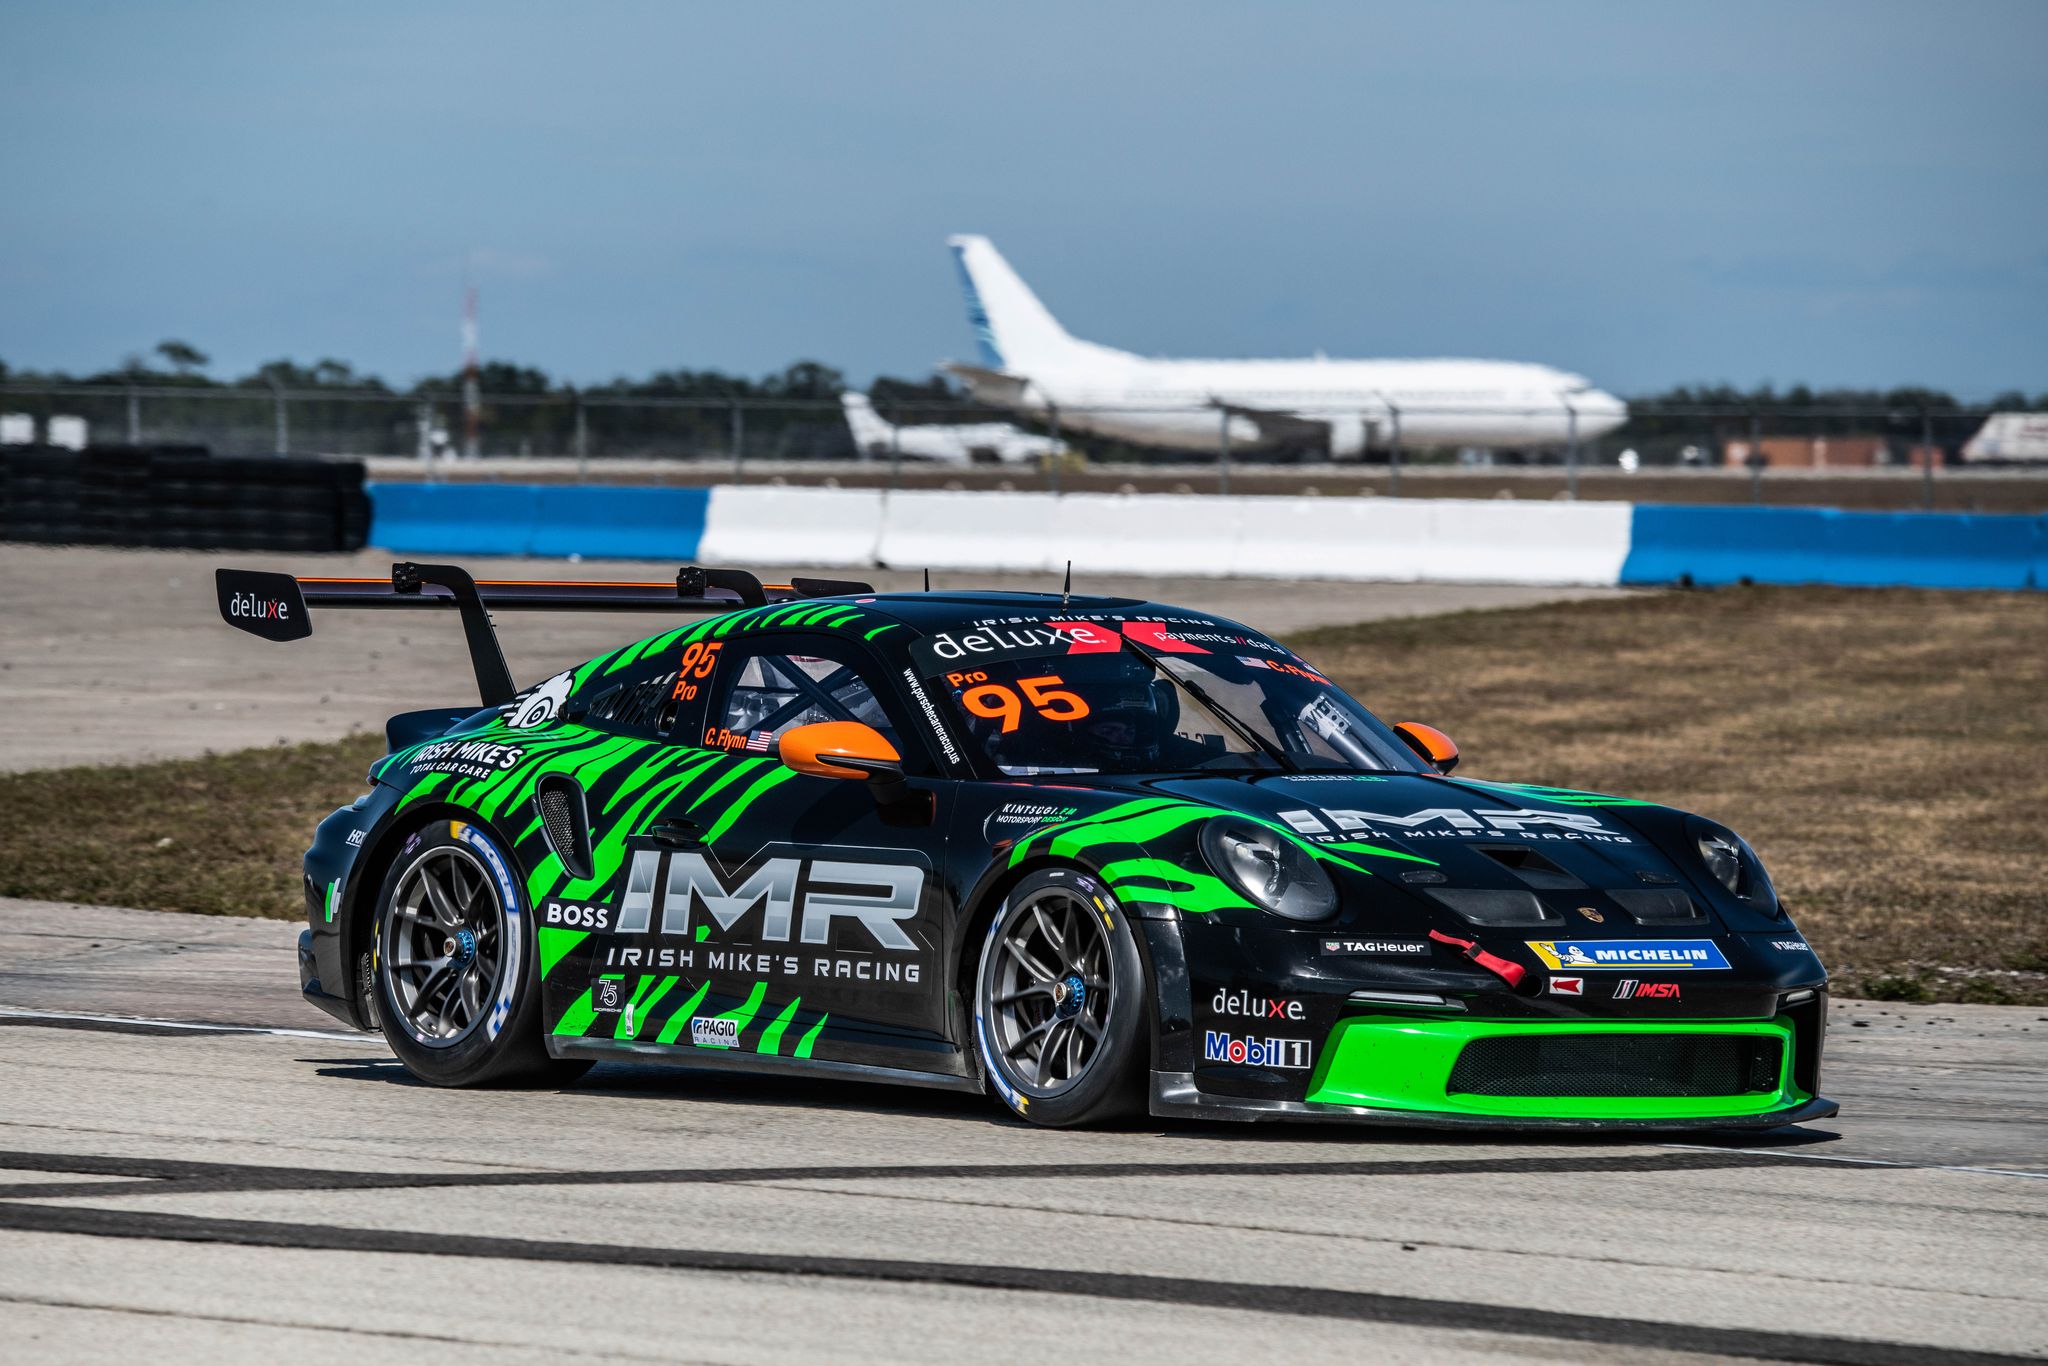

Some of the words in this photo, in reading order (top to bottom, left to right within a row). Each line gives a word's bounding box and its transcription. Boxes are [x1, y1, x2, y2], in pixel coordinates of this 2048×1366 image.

[973, 616, 1039, 626] IRISH
[1136, 616, 1215, 626] RACING
[679, 642, 723, 679] 95
[672, 681, 698, 700] Pro
[946, 671, 988, 687] Pro
[903, 668, 960, 764] www.porschecarreracup.us
[962, 675, 1090, 734] 95
[705, 727, 715, 746] C.
[717, 728, 747, 751] Flynn
[411, 742, 461, 764] IRISH
[451, 741, 524, 769] MIKE'S
[410, 762, 437, 775] TOTAL
[436, 762, 458, 772] CAR
[458, 763, 491, 779] CARE
[1002, 803, 1077, 815] KINTSUGI.FM
[1276, 808, 1622, 835] IMR
[1305, 831, 1391, 844] IRISH
[1405, 829, 1504, 838] MIKE'S
[1520, 831, 1633, 844] RACING
[615, 850, 925, 951] IMR
[546, 902, 609, 929] BOSS
[607, 948, 694, 968] IRISH
[708, 951, 799, 975] MIKE'S
[813, 958, 920, 983] RACING
[1596, 949, 1708, 961] MICHELIN
[599, 979, 618, 1007] 75
[703, 1019, 736, 1037] PAGID
[694, 1036, 738, 1046] RACING
[1205, 1030, 1281, 1067] Mobil
[1291, 1042, 1302, 1066] 1
